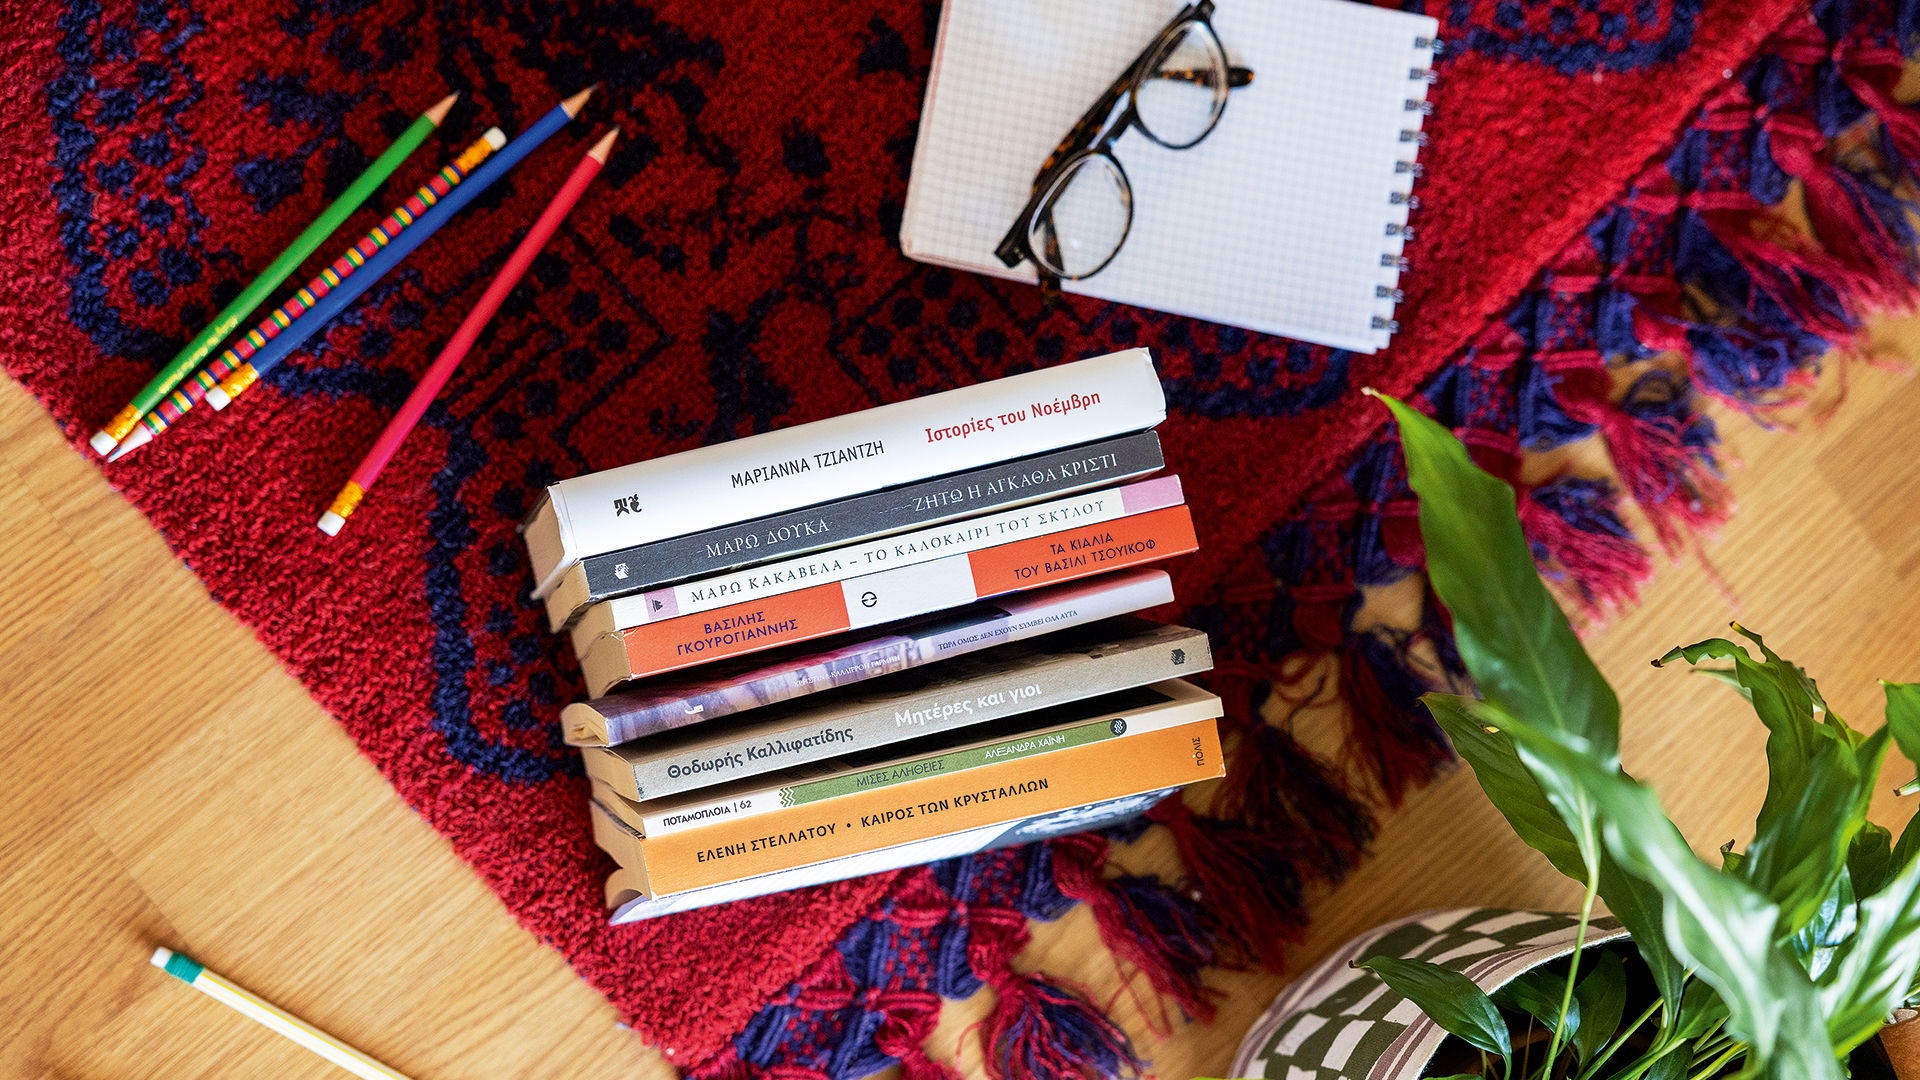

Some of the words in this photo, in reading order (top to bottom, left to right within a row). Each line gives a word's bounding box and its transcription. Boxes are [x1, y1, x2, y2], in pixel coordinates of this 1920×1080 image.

[925, 417, 995, 443] Ιστορίες
[997, 410, 1026, 427] του
[1030, 392, 1101, 419] Νοέμβρη
[731, 457, 811, 489] ΜΑΡΙΑΝΝΑ
[813, 440, 885, 469] ΤΖΙΑΝΤΖΗ
[912, 488, 963, 512] ΖΗΤΩ
[967, 485, 981, 499] Η
[986, 468, 1057, 495] ΑΓΚΑΘΑ
[1060, 453, 1118, 478] ΚΡΙΣΤΙ
[691, 582, 742, 602] ΜΑΡΩ
[748, 559, 843, 590] ΚΑΚΑΒΕΛΑ
[863, 548, 888, 563] ΤΟ
[894, 526, 991, 558] ΚΑΛΟΚΑΙΡΙ
[996, 517, 1030, 534] ΤΟΥ
[1038, 500, 1104, 525] ΣΚΥΛΟΥ
[705, 534, 760, 558] ΜΑΡΩ
[766, 518, 830, 545] ΔΟΥΚΑ
[1050, 543, 1066, 555] ΤΑ
[1069, 532, 1114, 551] ΚΙΑΛΙΑ
[1014, 565, 1039, 580] ΤΟΥ
[1044, 554, 1087, 574] ΒΑΣΙΛΙ
[1091, 539, 1156, 563] ΤΣΟΥΙΚΟΦ
[676, 618, 799, 656] ΓΚΟΥΡΟΓΙΑΝΝΗΣ
[703, 611, 766, 635] ΒΑΣΙΛΗΣ
[938, 641, 957, 650] ΤΩΡΑ
[957, 636, 979, 646] ΟΜΩΣ
[980, 631, 994, 640] ΔΕΝ
[994, 625, 1018, 637] ΕΧΟΥΝ
[1018, 618, 1044, 630] ΣΥΜΒΕΙ
[1044, 614, 1060, 624] ΟΛΑ
[1060, 610, 1078, 620] ΑΥΤΑ
[894, 700, 974, 727] Μητέρες
[976, 692, 1006, 709] και
[1008, 683, 1043, 704] γιοι
[667, 752, 744, 779] Θοδωρής
[745, 727, 854, 761] Καλλιφατίδης
[985, 741, 1037, 760] ΑΛΕΞΑΝΔΡΑ
[1037, 734, 1066, 748] ΧΑΪΝΗ
[1191, 736, 1205, 767] ΠΟΛΙΣ
[856, 773, 889, 787] ΜΙΣΕΣ
[891, 759, 945, 779] ΑΛΗΘΕΙΕΣ
[663, 806, 731, 827] ΠΟΤΑΜΟΠΛΟΙΑ
[740, 800, 752, 810] 62
[696, 842, 747, 863] ΕΛΕΝΗ
[750, 823, 836, 852] ΣΤΕΛΛΑΤΟΥ
[861, 807, 915, 828] ΚΑΙΡΟΣ
[917, 799, 949, 815] ΤΩΝ
[953, 778, 1049, 808] ΚΡΥΣΤΑΛΛΩΝ
